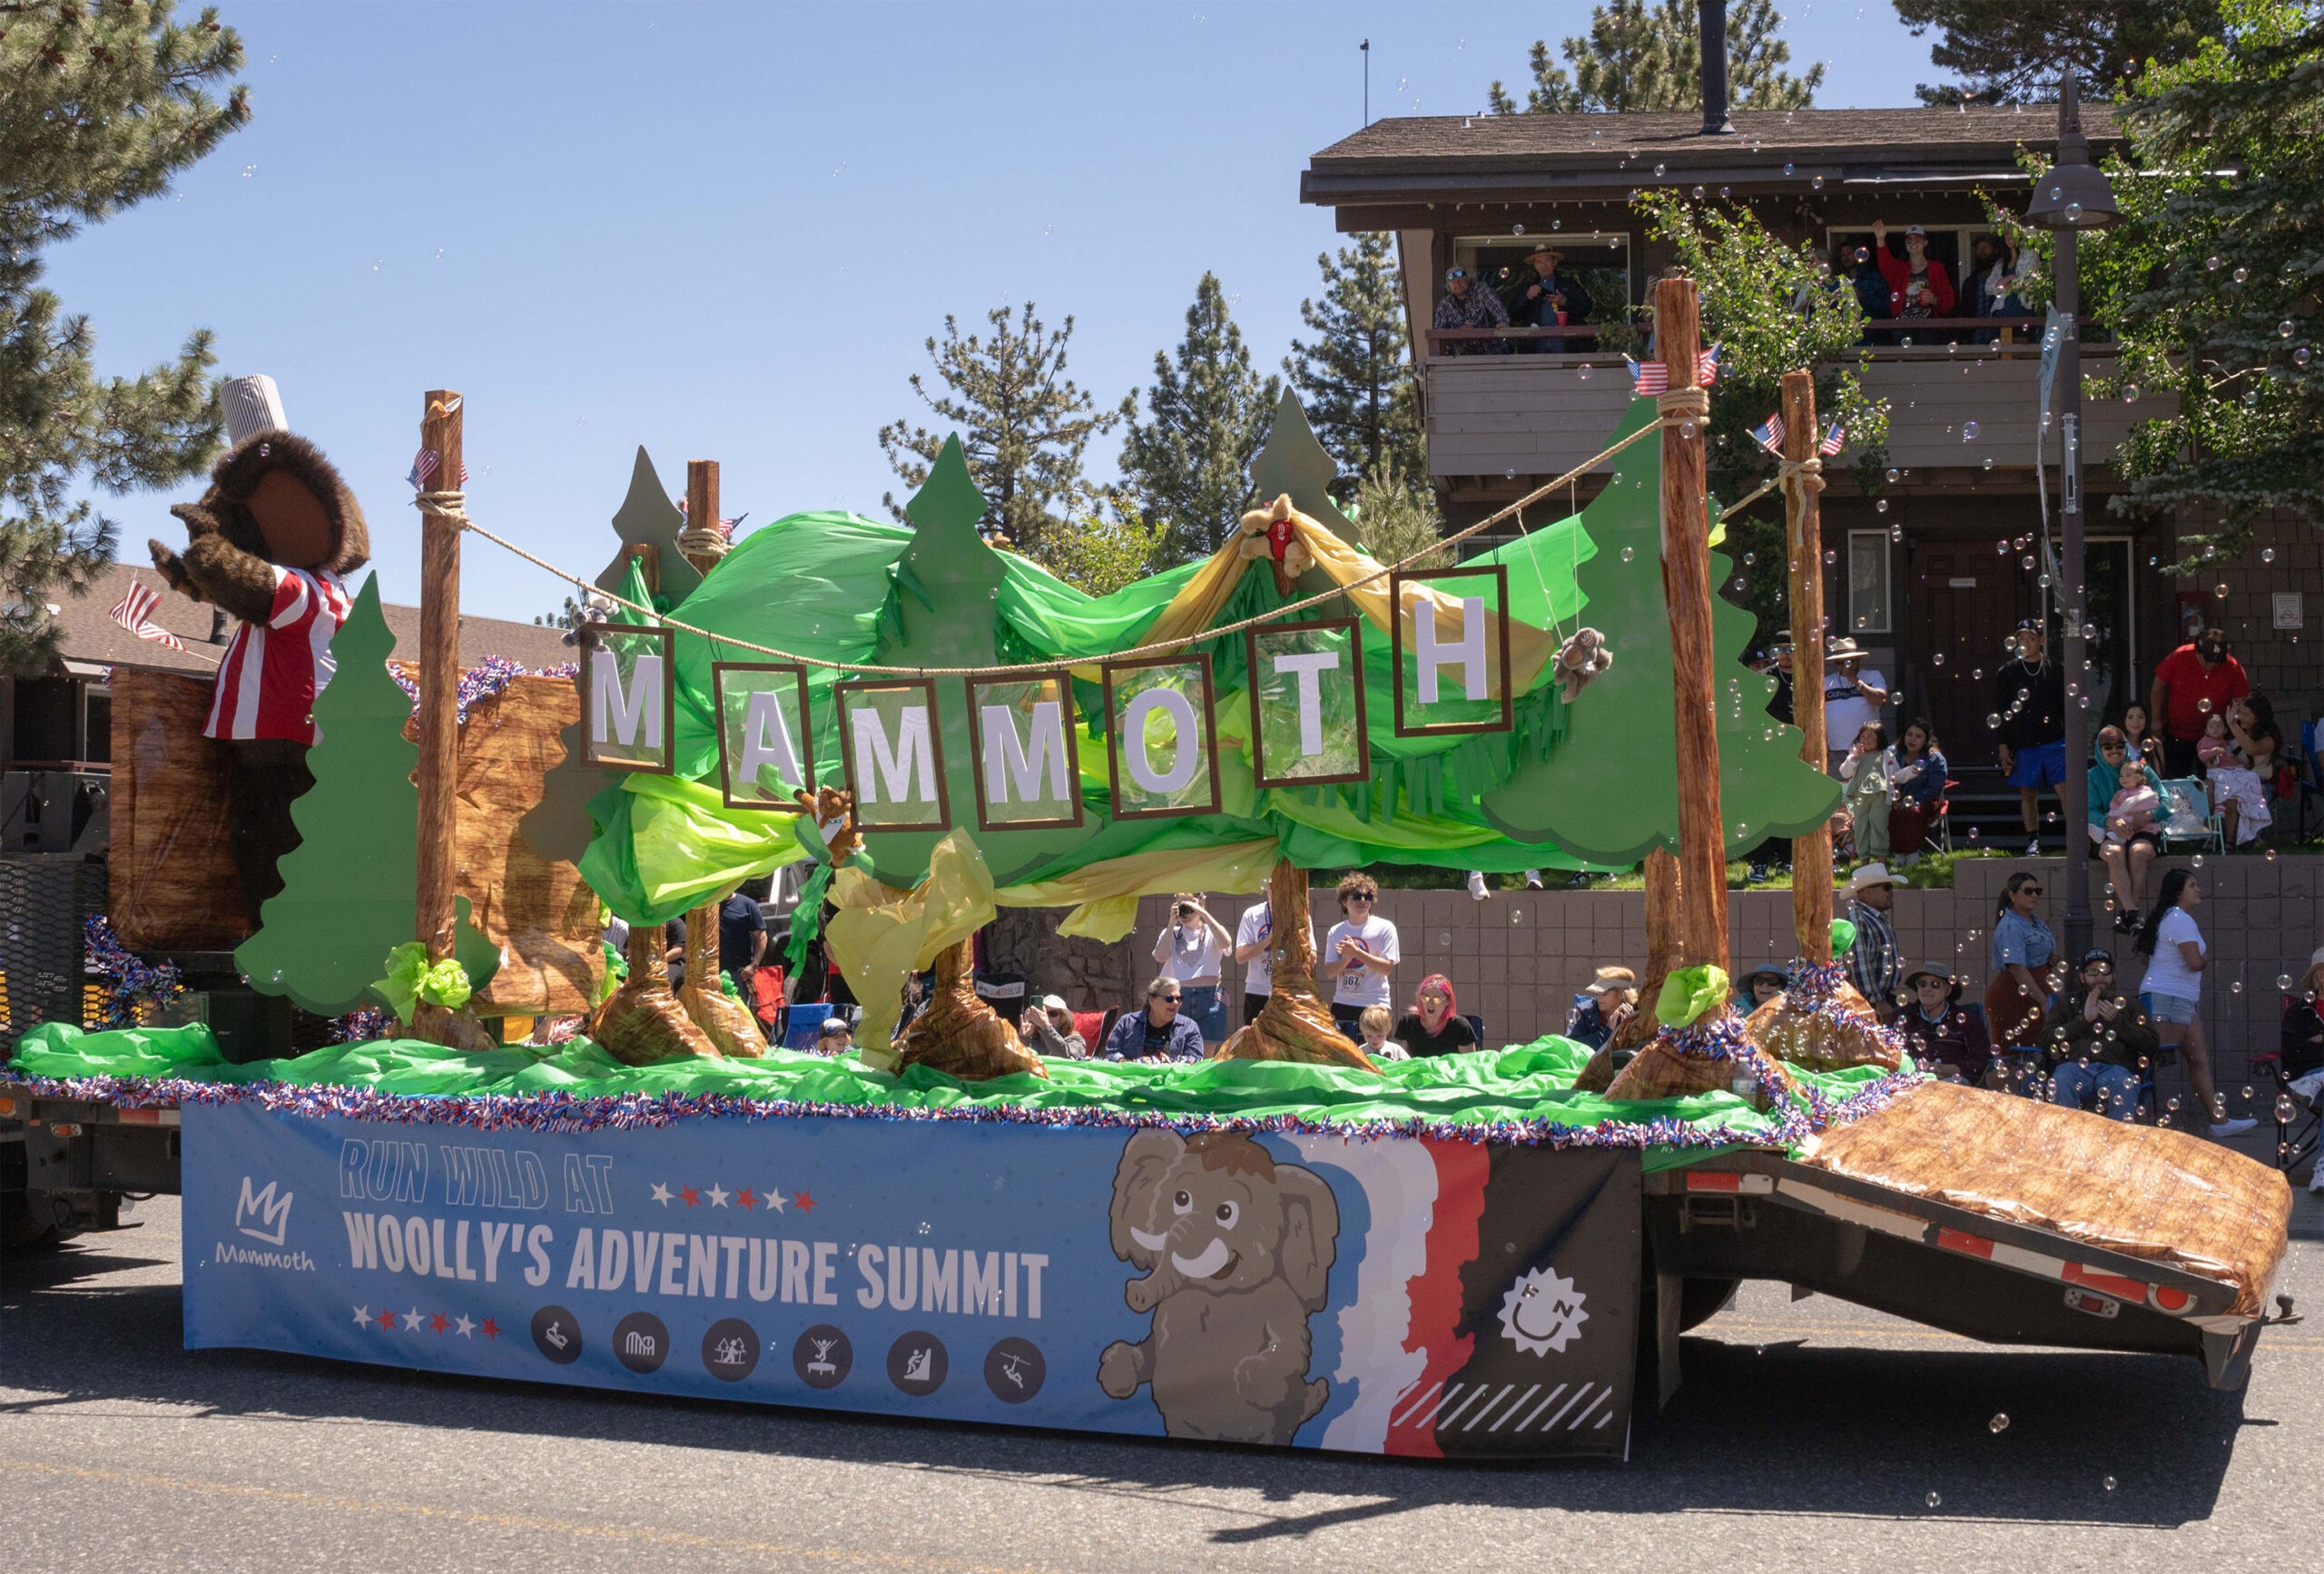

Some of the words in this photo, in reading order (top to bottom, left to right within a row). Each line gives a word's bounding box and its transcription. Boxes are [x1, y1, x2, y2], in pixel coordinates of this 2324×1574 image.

[592, 596, 1487, 804] MAMMOTH
[340, 1138, 428, 1203] RUN
[440, 1145, 548, 1211] WILD
[566, 1154, 614, 1215] AT
[215, 1241, 316, 1271] Mammoth
[342, 1211, 554, 1287] WOOLLY'S
[566, 1228, 838, 1306] ADVENTURE
[857, 1244, 1049, 1319] SUMMIT
